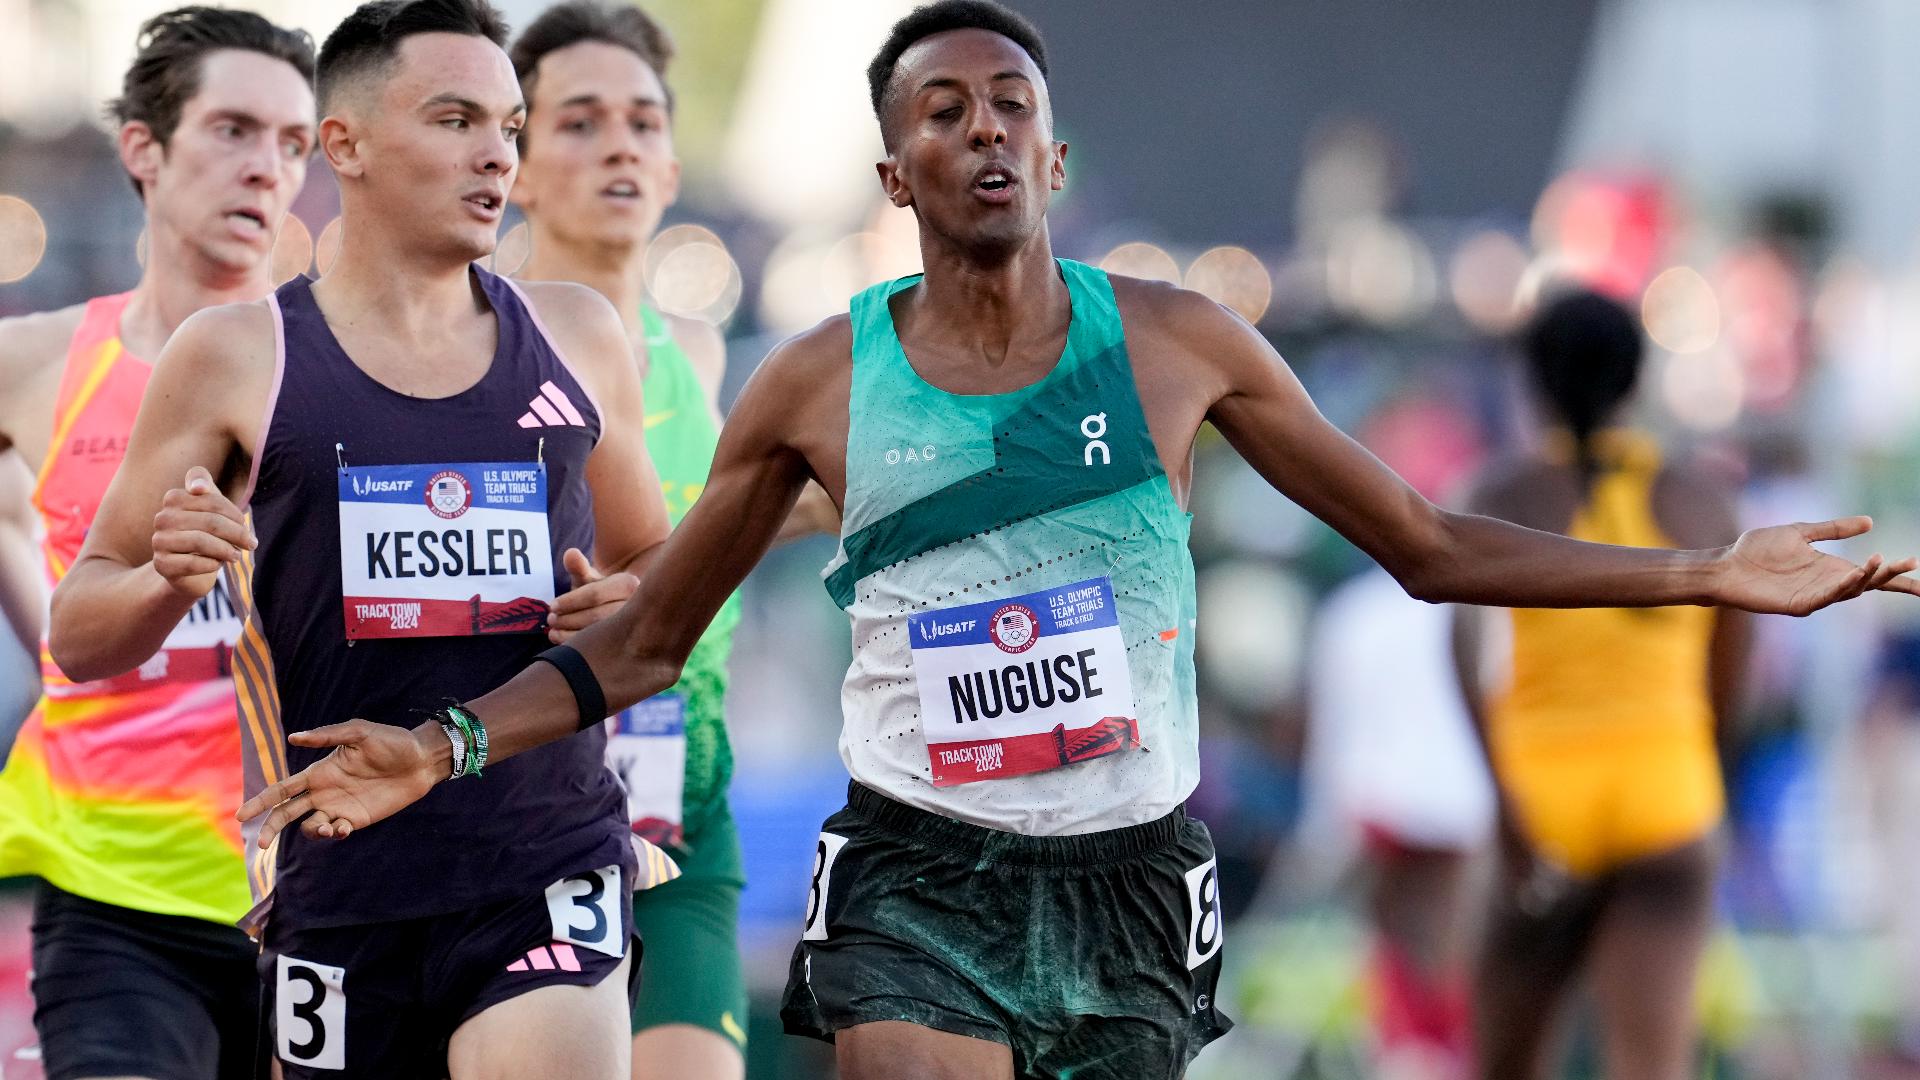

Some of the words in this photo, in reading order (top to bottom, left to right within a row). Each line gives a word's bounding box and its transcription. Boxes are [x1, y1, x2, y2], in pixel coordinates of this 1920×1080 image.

[885, 445, 936, 464] OAC
[484, 470, 499, 481] U.S.
[502, 470, 536, 481] OLYMPIC
[371, 480, 413, 492] USATF
[484, 483, 506, 493] TEAM
[508, 483, 536, 493] TRIALS
[486, 495, 504, 503] TRACK
[510, 495, 524, 503] FIELD
[367, 529, 531, 579] KESSLER
[1049, 594, 1067, 608] U.S.
[1067, 585, 1102, 603] OLYMPIC
[355, 603, 421, 619] TRACKTOWN
[1051, 605, 1075, 620] TEAM
[1076, 597, 1104, 613] TRIALS
[390, 616, 418, 630] 2024
[938, 619, 977, 636] USATF
[1055, 618, 1075, 630] TRACK
[1080, 613, 1094, 624] FIELD
[948, 648, 1103, 724] NUGUSE
[939, 743, 1003, 765] TRACKTOWN
[975, 756, 1002, 773] 2024
[562, 871, 608, 943] 3
[1195, 866, 1218, 956] 8
[288, 965, 326, 1060] 3
